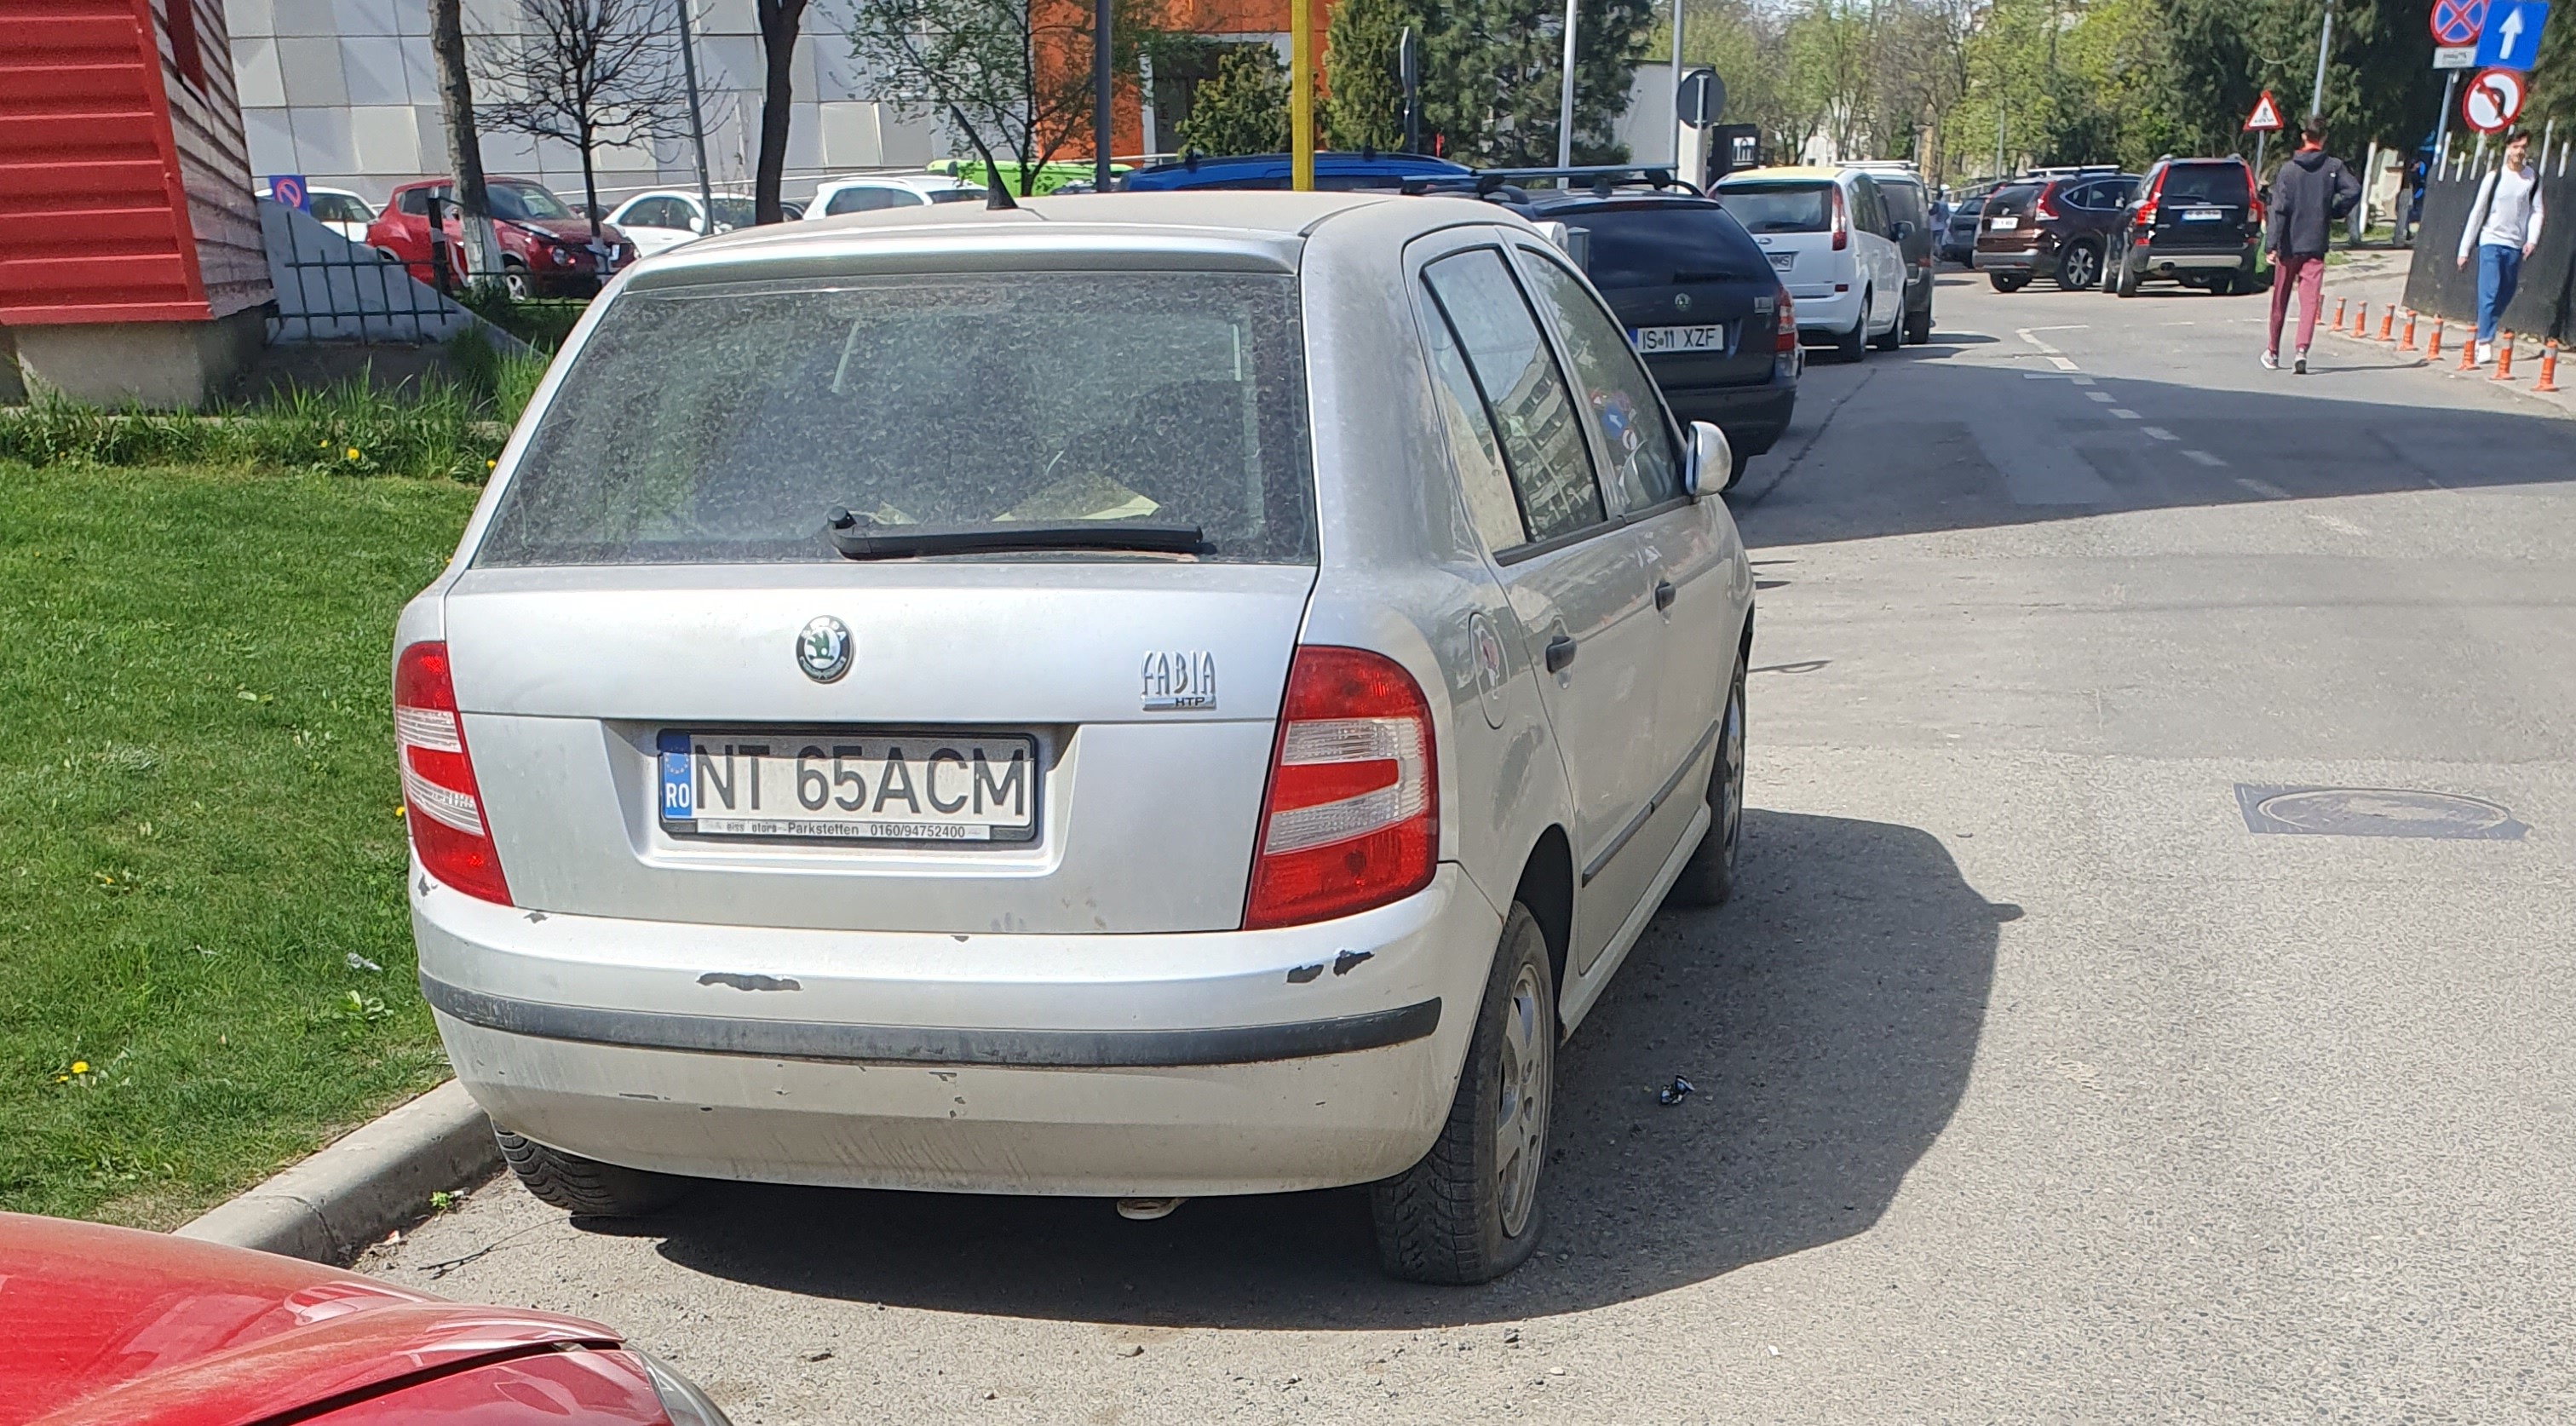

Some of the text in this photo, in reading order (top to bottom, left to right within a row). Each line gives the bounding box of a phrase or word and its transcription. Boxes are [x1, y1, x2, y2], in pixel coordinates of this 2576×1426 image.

[1642, 328, 1716, 350] IS 11 XZF
[1141, 650, 1216, 695] FABIA
[1176, 697, 1205, 706] HTP
[695, 745, 1025, 816] NT 65ACM
[665, 782, 690, 808] RO
[788, 822, 860, 836] Parkstetten
[870, 824, 966, 838] 0160/94752400
